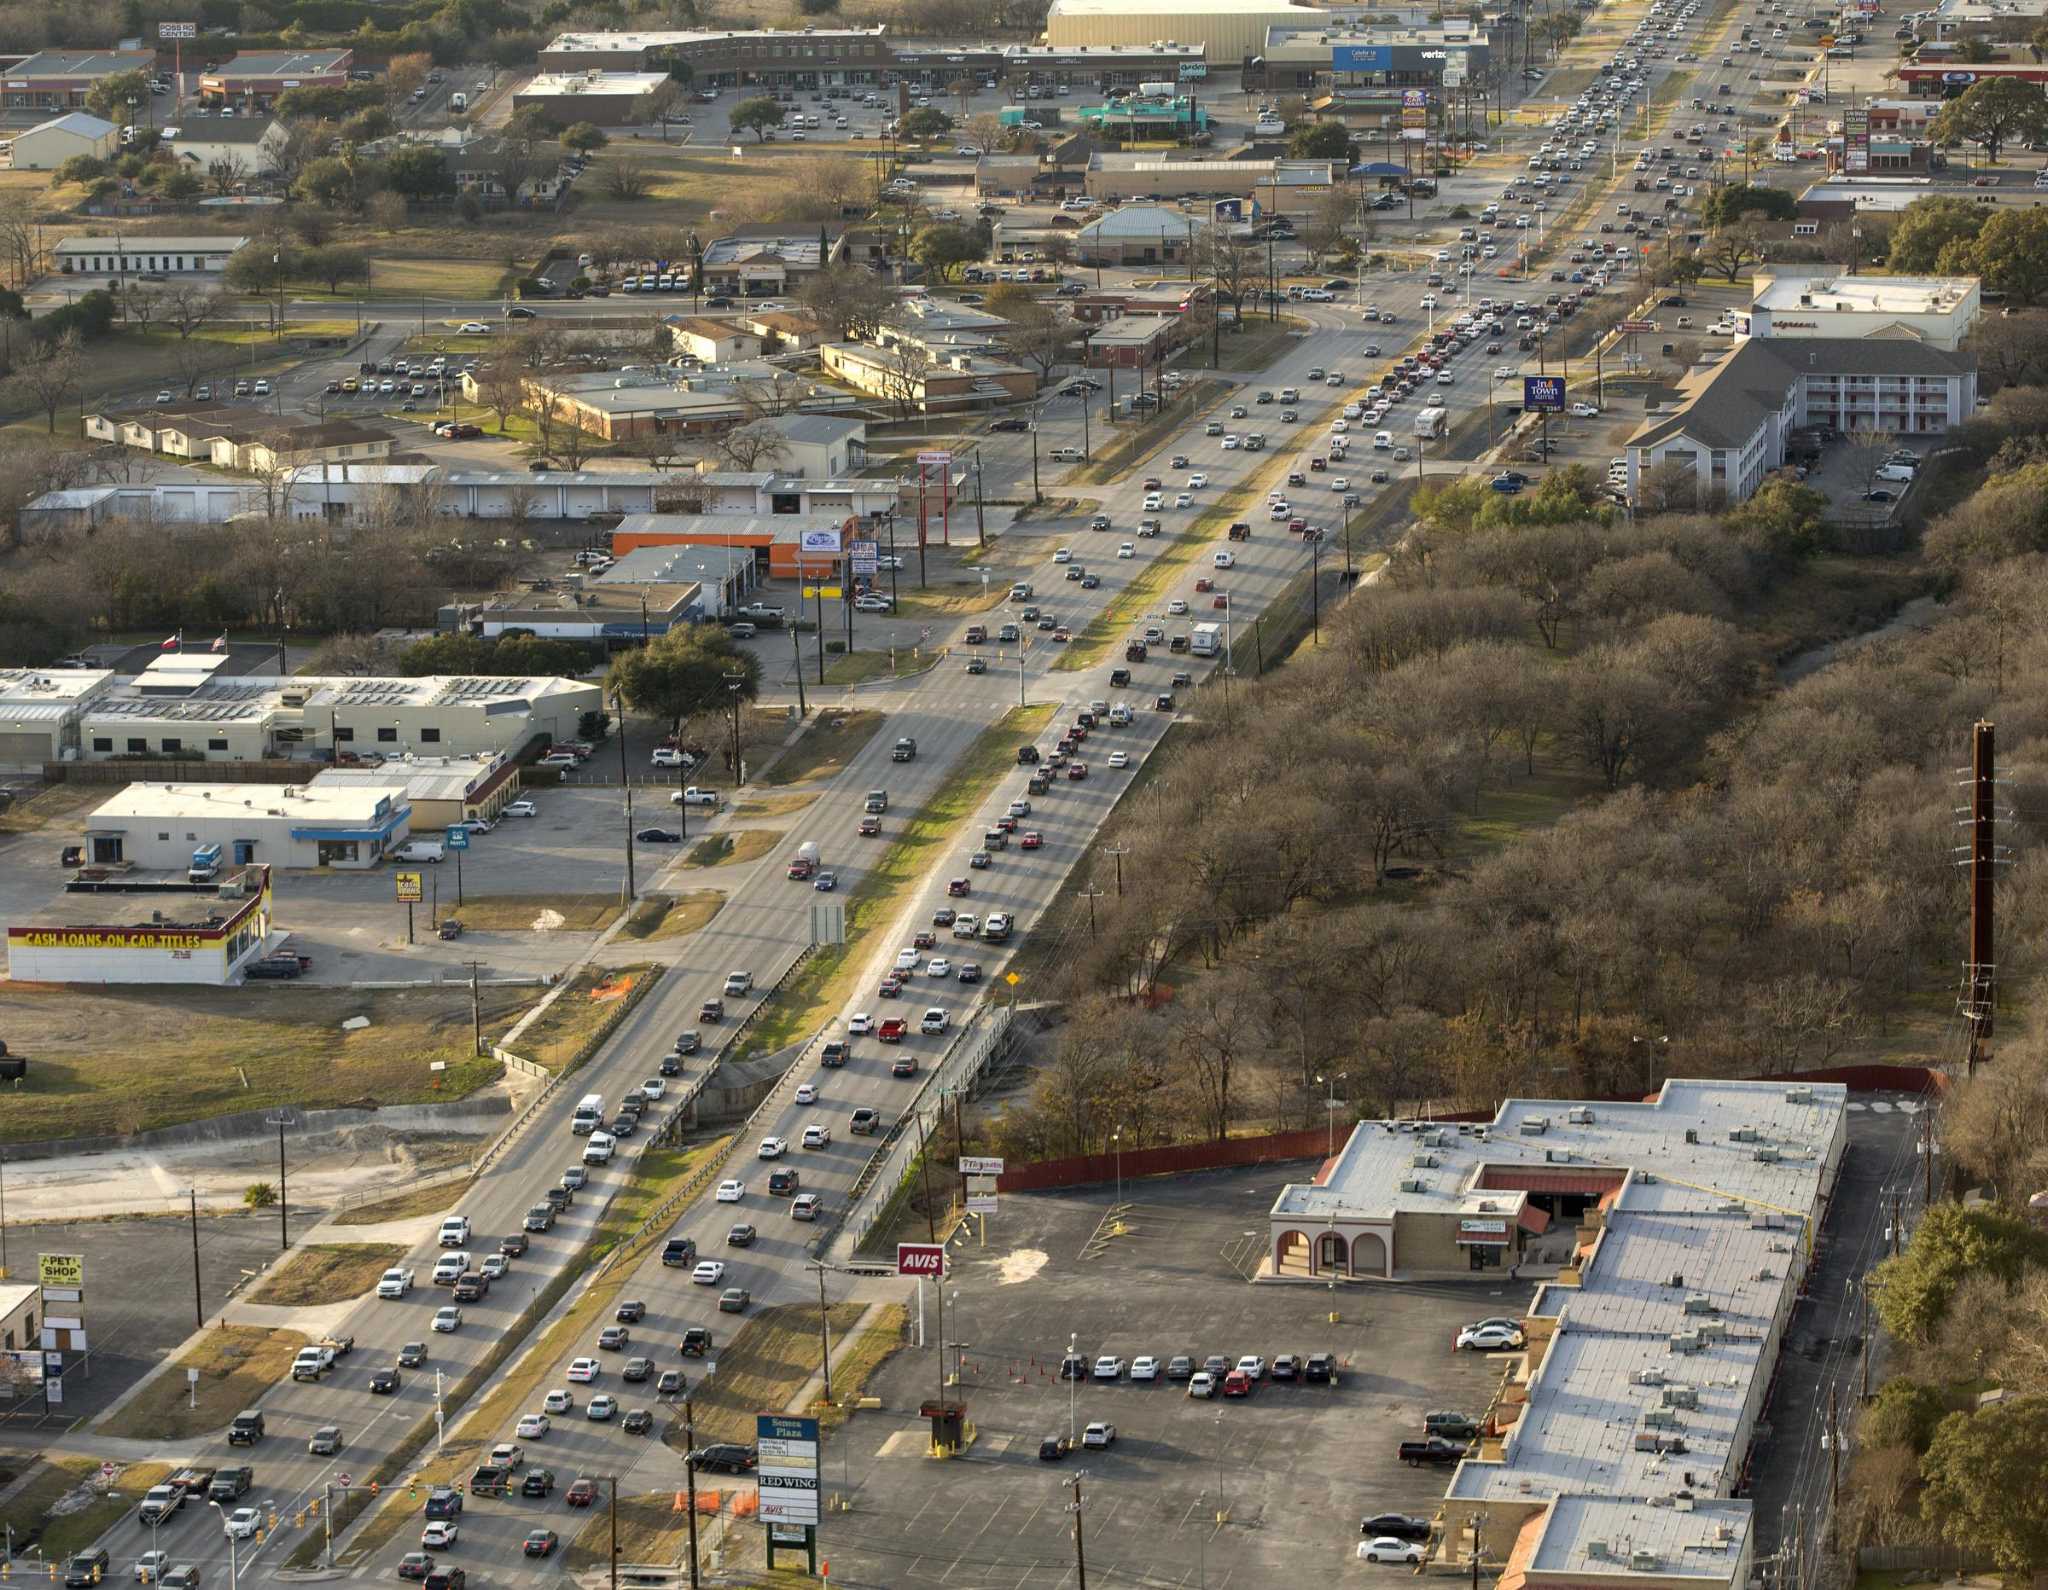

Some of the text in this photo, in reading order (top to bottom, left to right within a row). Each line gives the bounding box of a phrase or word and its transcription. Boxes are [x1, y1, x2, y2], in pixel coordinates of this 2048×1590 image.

[1531, 386, 1558, 395] Town
[25, 933, 201, 948] CASH LOANS ON CAR TITLES
[50, 1255, 72, 1266] PET
[902, 1253, 940, 1269] AVIS
[45, 1266, 78, 1276] SHOP
[776, 1427, 803, 1437] Plaza
[760, 1476, 817, 1488] RED WING
[764, 1504, 784, 1513] AVIS
